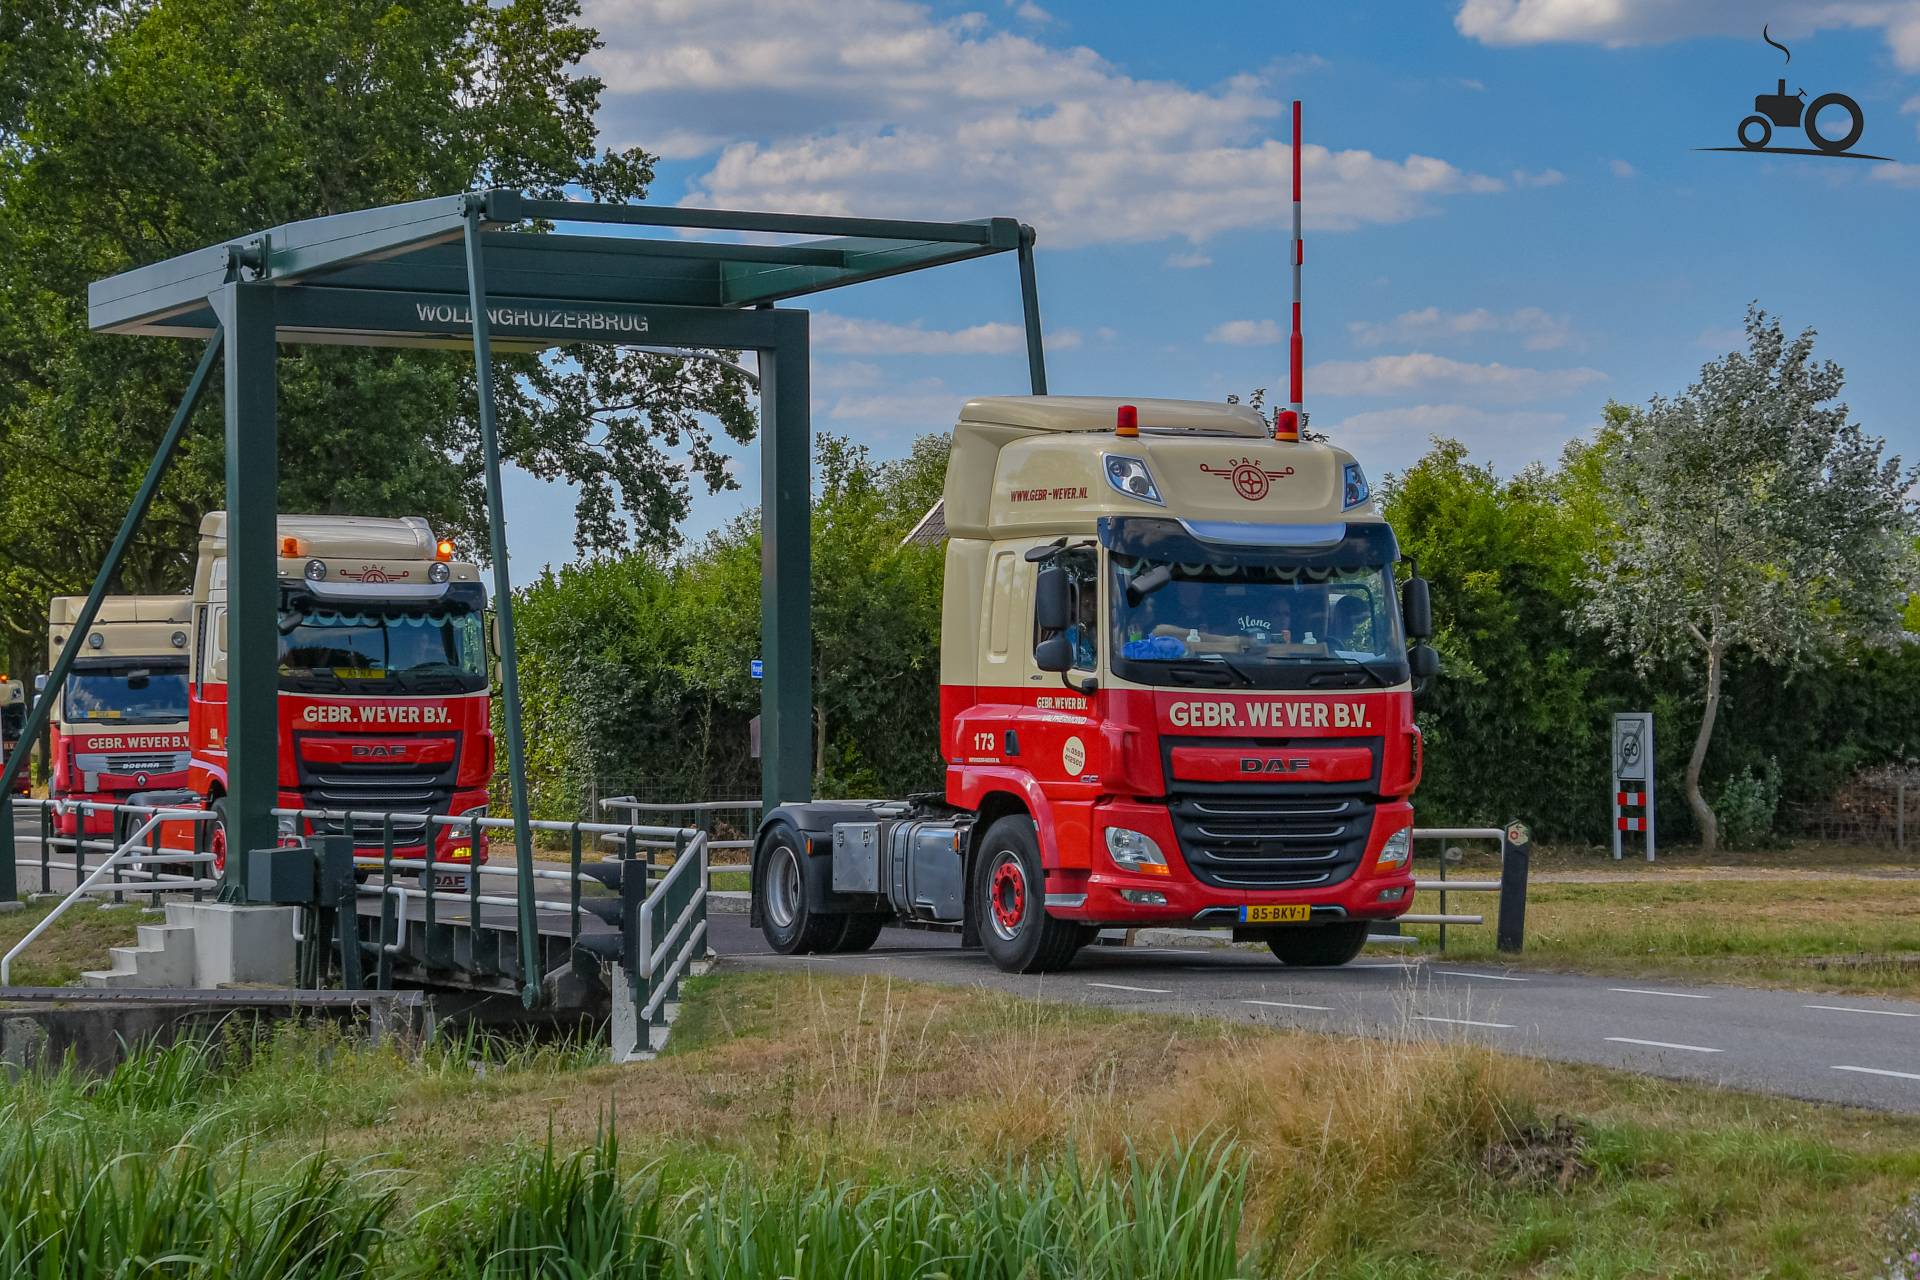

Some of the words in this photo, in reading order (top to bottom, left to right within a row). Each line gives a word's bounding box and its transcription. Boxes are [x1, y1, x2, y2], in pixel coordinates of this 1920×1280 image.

[416, 303, 648, 332] WOLLNGHUIZERBRUG
[1229, 457, 1262, 467] DAF
[1011, 486, 1088, 502] WWW.GEBR-WEVER.NL
[362, 564, 386, 572] DAF
[1036, 696, 1055, 709] GEBR.
[1055, 697, 1076, 710] WEVER
[303, 706, 358, 723] GEBR.
[359, 706, 420, 723] WEVER
[423, 707, 452, 723] B.V.
[1169, 701, 1244, 727] GEBR.
[1246, 702, 1329, 727] WEVER
[1334, 703, 1372, 728] B.V.
[87, 737, 125, 749] GEBR.
[127, 736, 169, 748] WEVER
[172, 735, 189, 747] B.V
[974, 733, 995, 750] 173
[351, 745, 407, 757] DAF
[1624, 743, 1638, 757] 60
[1240, 757, 1310, 773] DAF
[1252, 907, 1306, 920] 85-BKV-1
